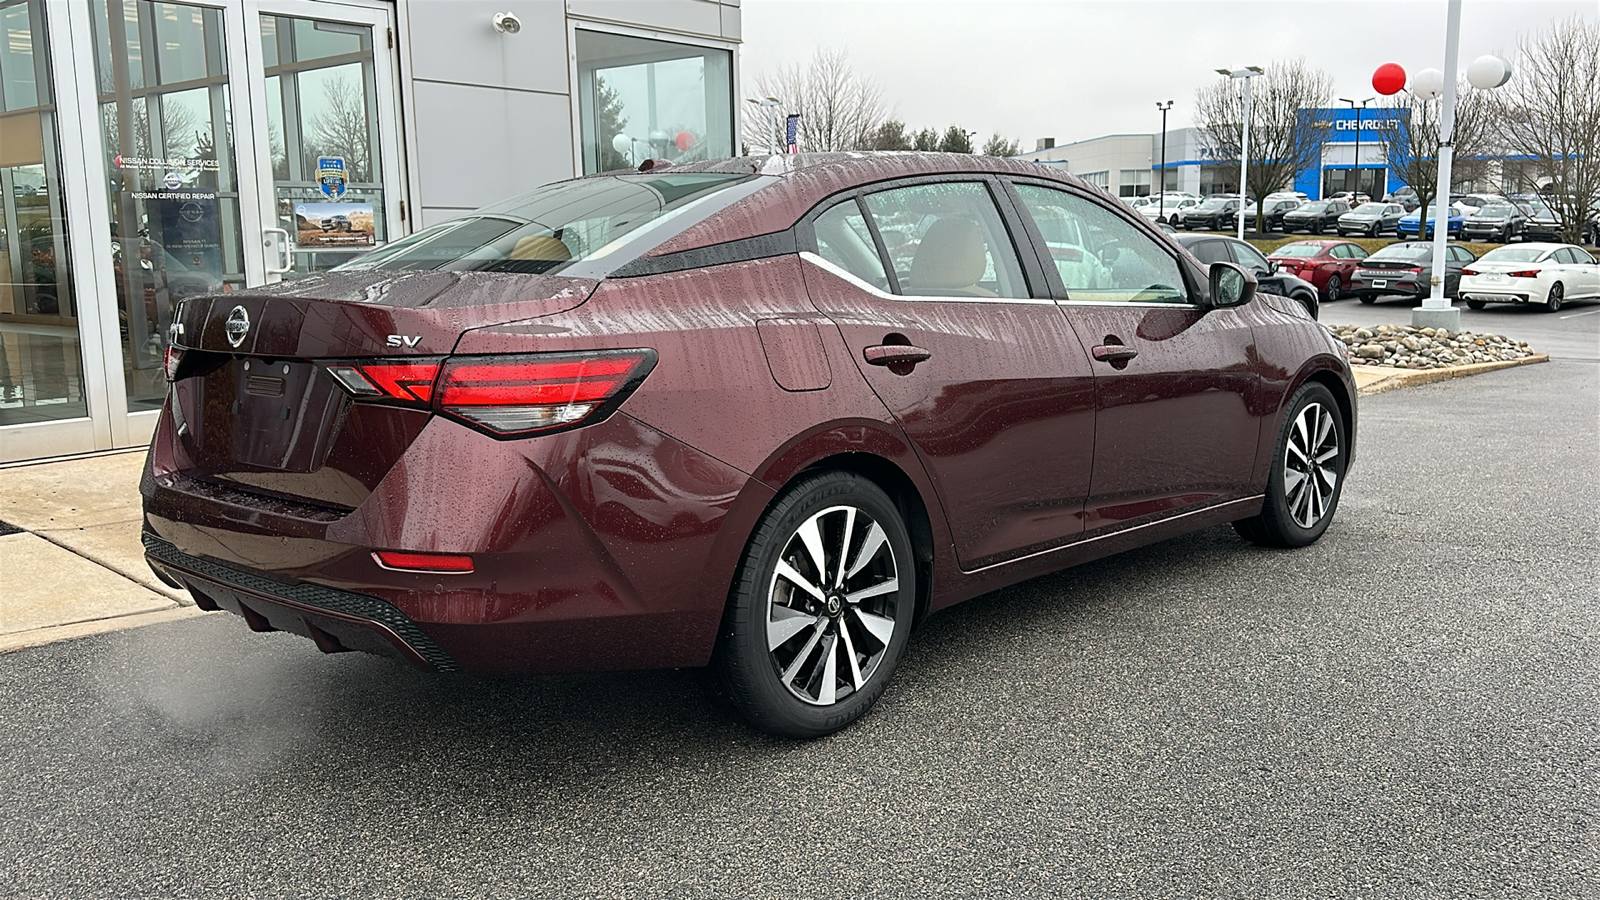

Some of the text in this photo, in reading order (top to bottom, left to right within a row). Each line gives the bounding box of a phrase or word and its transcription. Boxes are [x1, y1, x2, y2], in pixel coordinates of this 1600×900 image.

[1336, 119, 1400, 130] CHEVROLET
[149, 158, 187, 166] COLLISION
[187, 159, 219, 167] SERVICES
[386, 334, 423, 348] SV
[790, 485, 854, 523] MICHELIN
